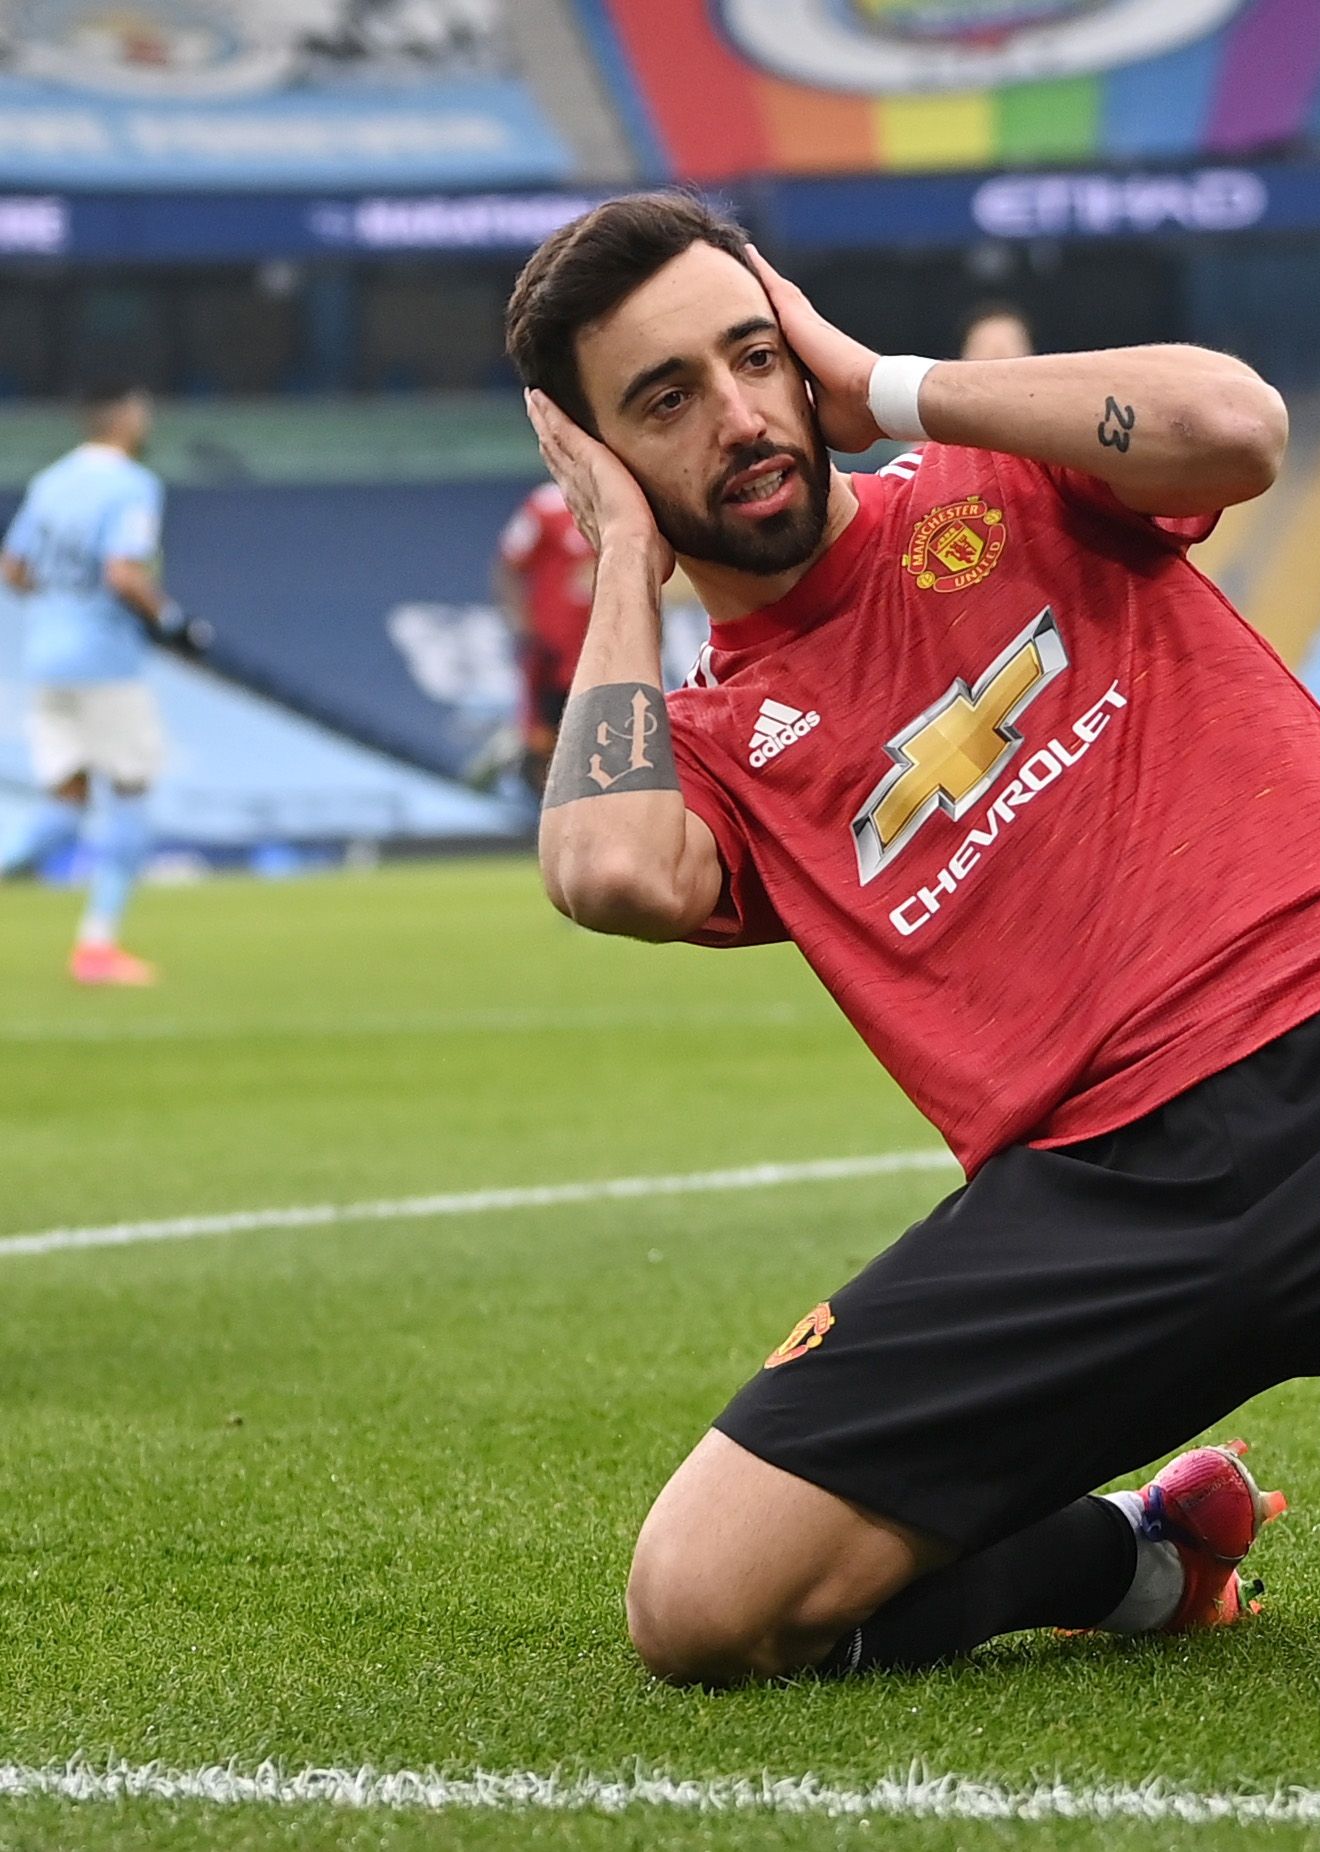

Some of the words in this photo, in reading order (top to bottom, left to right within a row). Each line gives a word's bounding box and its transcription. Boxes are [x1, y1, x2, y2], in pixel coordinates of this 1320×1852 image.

[1098, 396, 1135, 453] 23
[912, 504, 979, 566] MANCHESTER
[954, 541, 1000, 587] UNITED
[748, 710, 821, 768] adidas
[889, 679, 1128, 936] CHEVROLET
